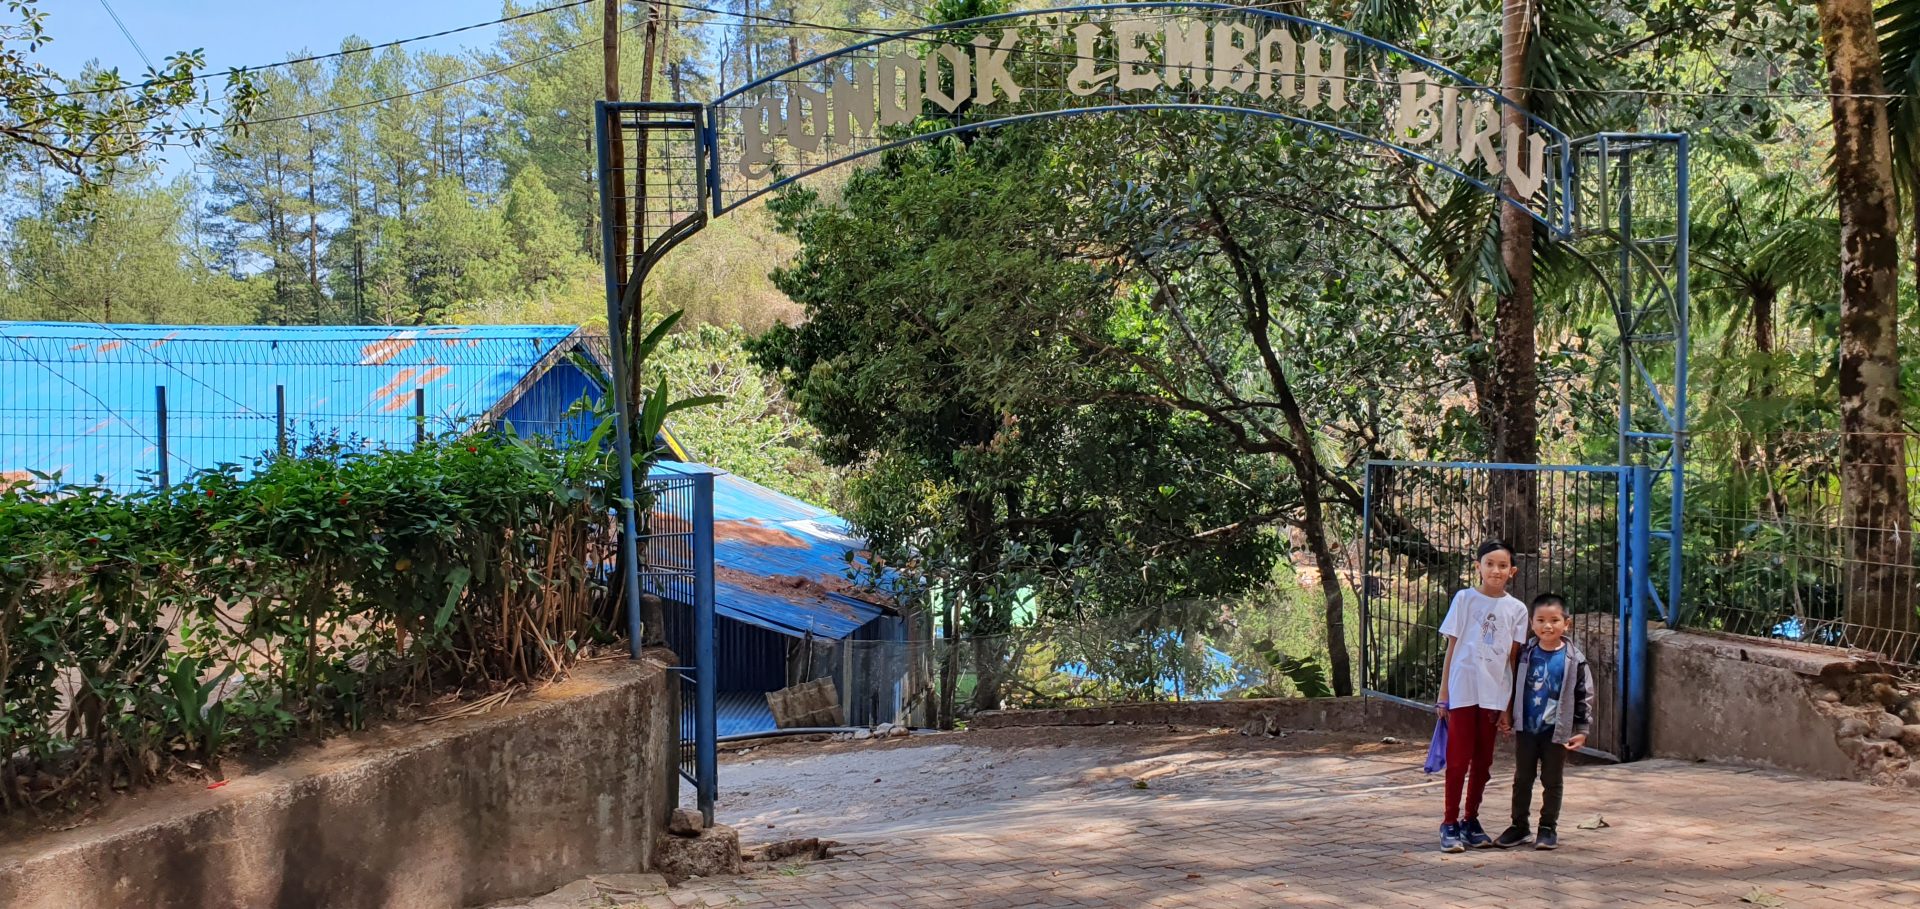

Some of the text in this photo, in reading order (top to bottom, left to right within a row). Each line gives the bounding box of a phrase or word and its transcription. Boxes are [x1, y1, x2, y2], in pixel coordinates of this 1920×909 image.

[739, 19, 1547, 200] PONDOK LEMBAH BIRU
